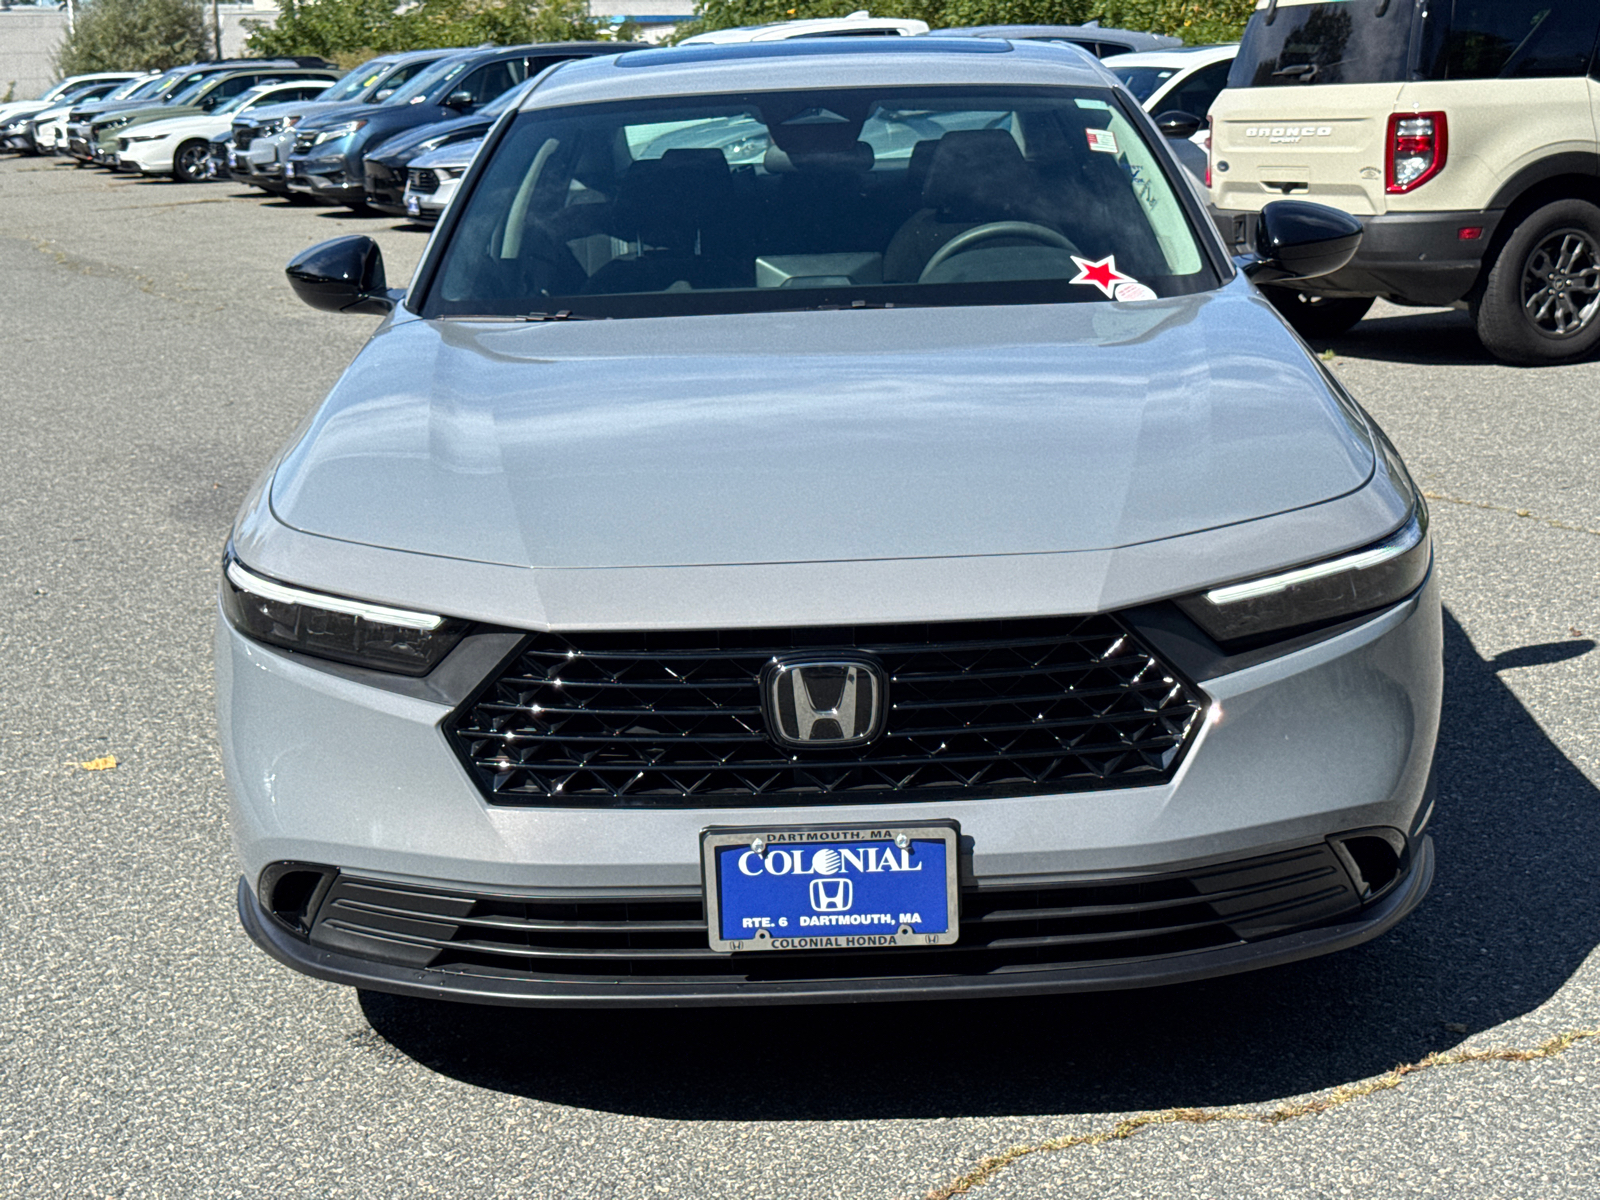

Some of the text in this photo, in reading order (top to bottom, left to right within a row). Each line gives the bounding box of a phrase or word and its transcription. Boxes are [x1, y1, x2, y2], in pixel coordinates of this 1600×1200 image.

[1245, 126, 1332, 138] BRONCO
[766, 830, 893, 843] DARTMOUTH, MA
[737, 846, 923, 876] COLONIAL
[742, 912, 922, 928] RTE. 6 DARTMOUTH, MA
[771, 935, 897, 949] COLONIAL HONDA
